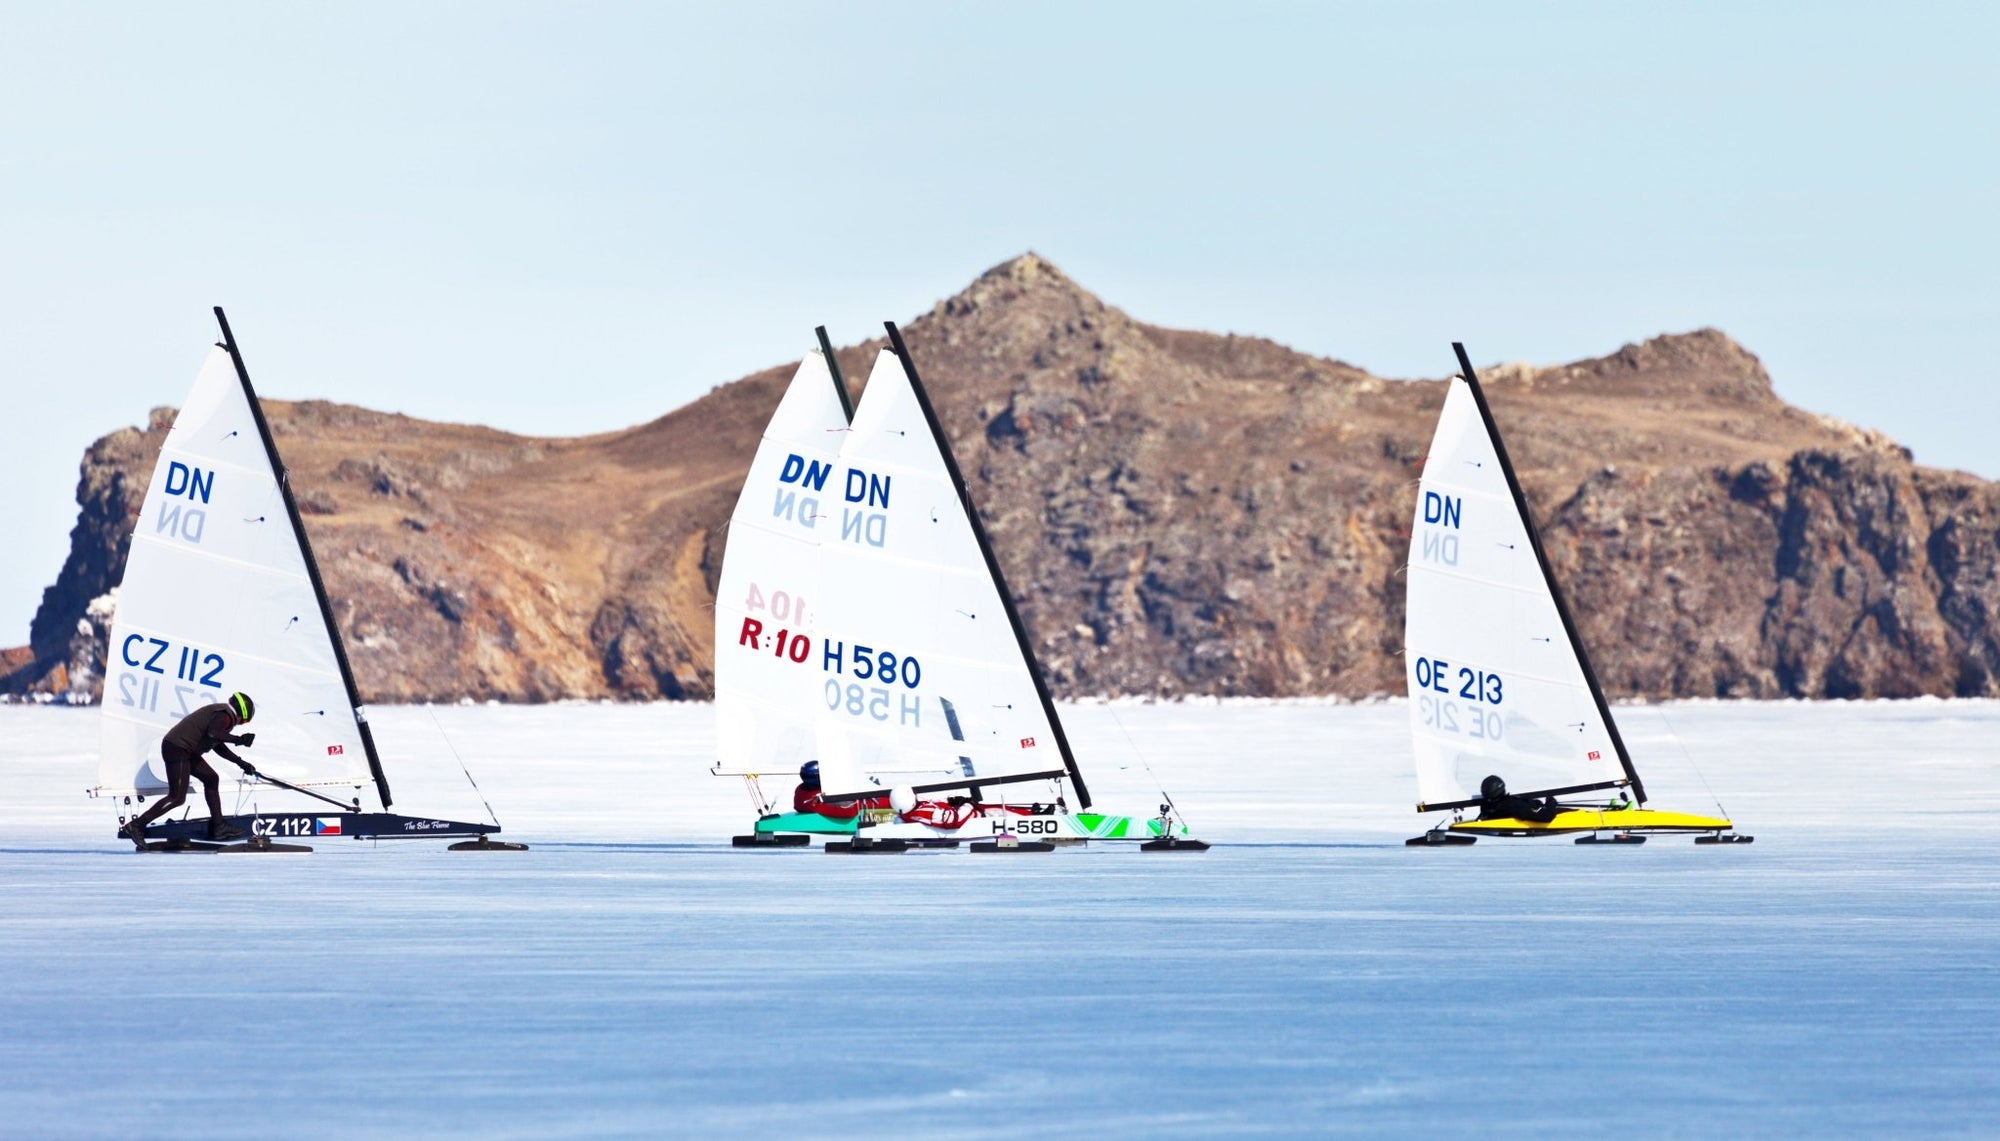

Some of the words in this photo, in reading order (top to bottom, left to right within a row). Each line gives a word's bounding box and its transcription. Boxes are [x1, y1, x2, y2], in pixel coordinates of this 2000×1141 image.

[164, 460, 215, 504] DN
[779, 453, 832, 492] DN
[845, 468, 891, 509] DN
[1424, 491, 1462, 530] DN
[122, 633, 170, 675] CZ
[177, 646, 225, 689] 112
[739, 617, 811, 664] R:10
[823, 638, 843, 674] H
[853, 645, 921, 689] 580
[1415, 657, 1449, 694] OE
[1459, 667, 1504, 705] 213
[252, 818, 278, 836] CZ
[281, 818, 311, 836] 112
[404, 821, 415, 830] The
[992, 820, 1058, 834] H-580
